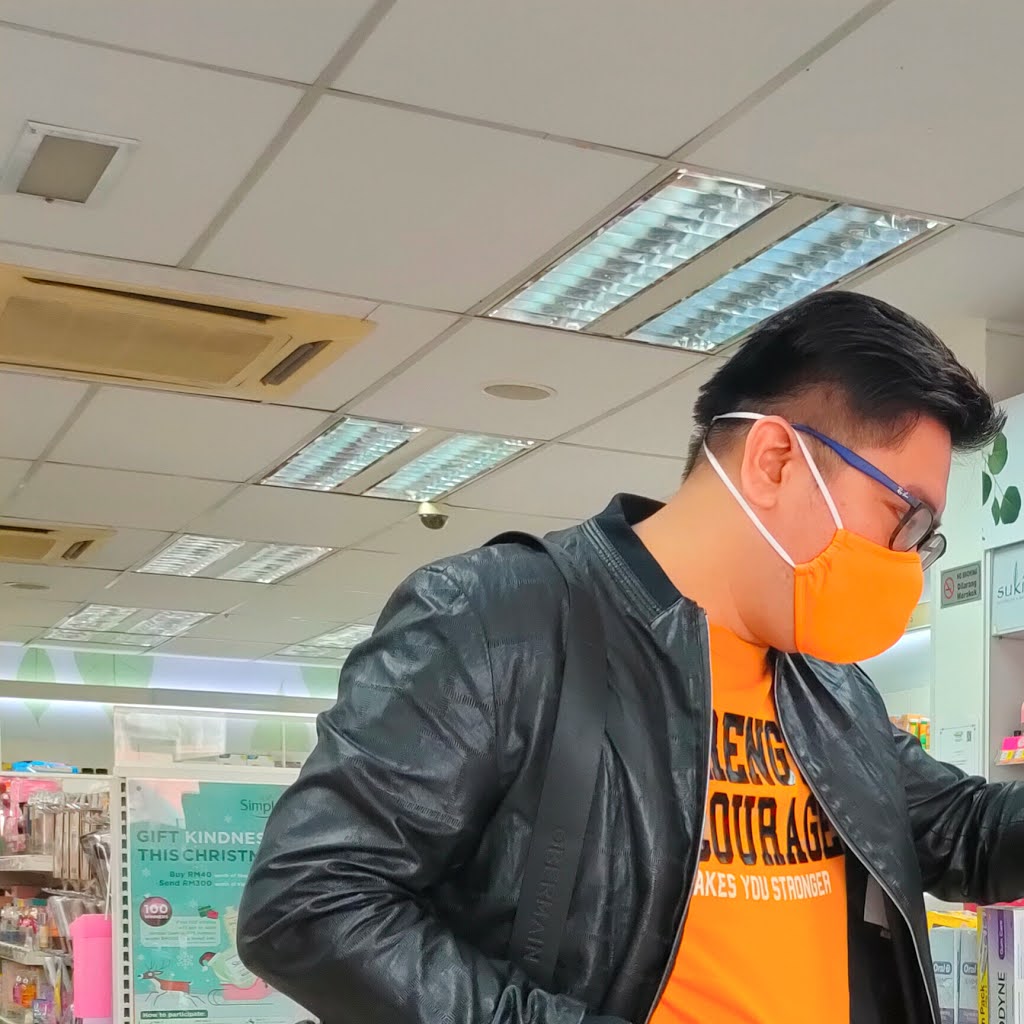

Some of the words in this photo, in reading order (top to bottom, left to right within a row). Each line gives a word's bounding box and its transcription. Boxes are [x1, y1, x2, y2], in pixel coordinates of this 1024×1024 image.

[710, 710, 795, 786] RENG
[701, 792, 844, 865] OURAGE
[137, 830, 179, 843] GIFT
[137, 849, 179, 862] THIS
[159, 879, 180, 887] Send
[692, 869, 737, 899] AKES
[741, 873, 769, 901] YOU
[772, 871, 832, 901] STRONGER
[144, 904, 168, 914] 100
